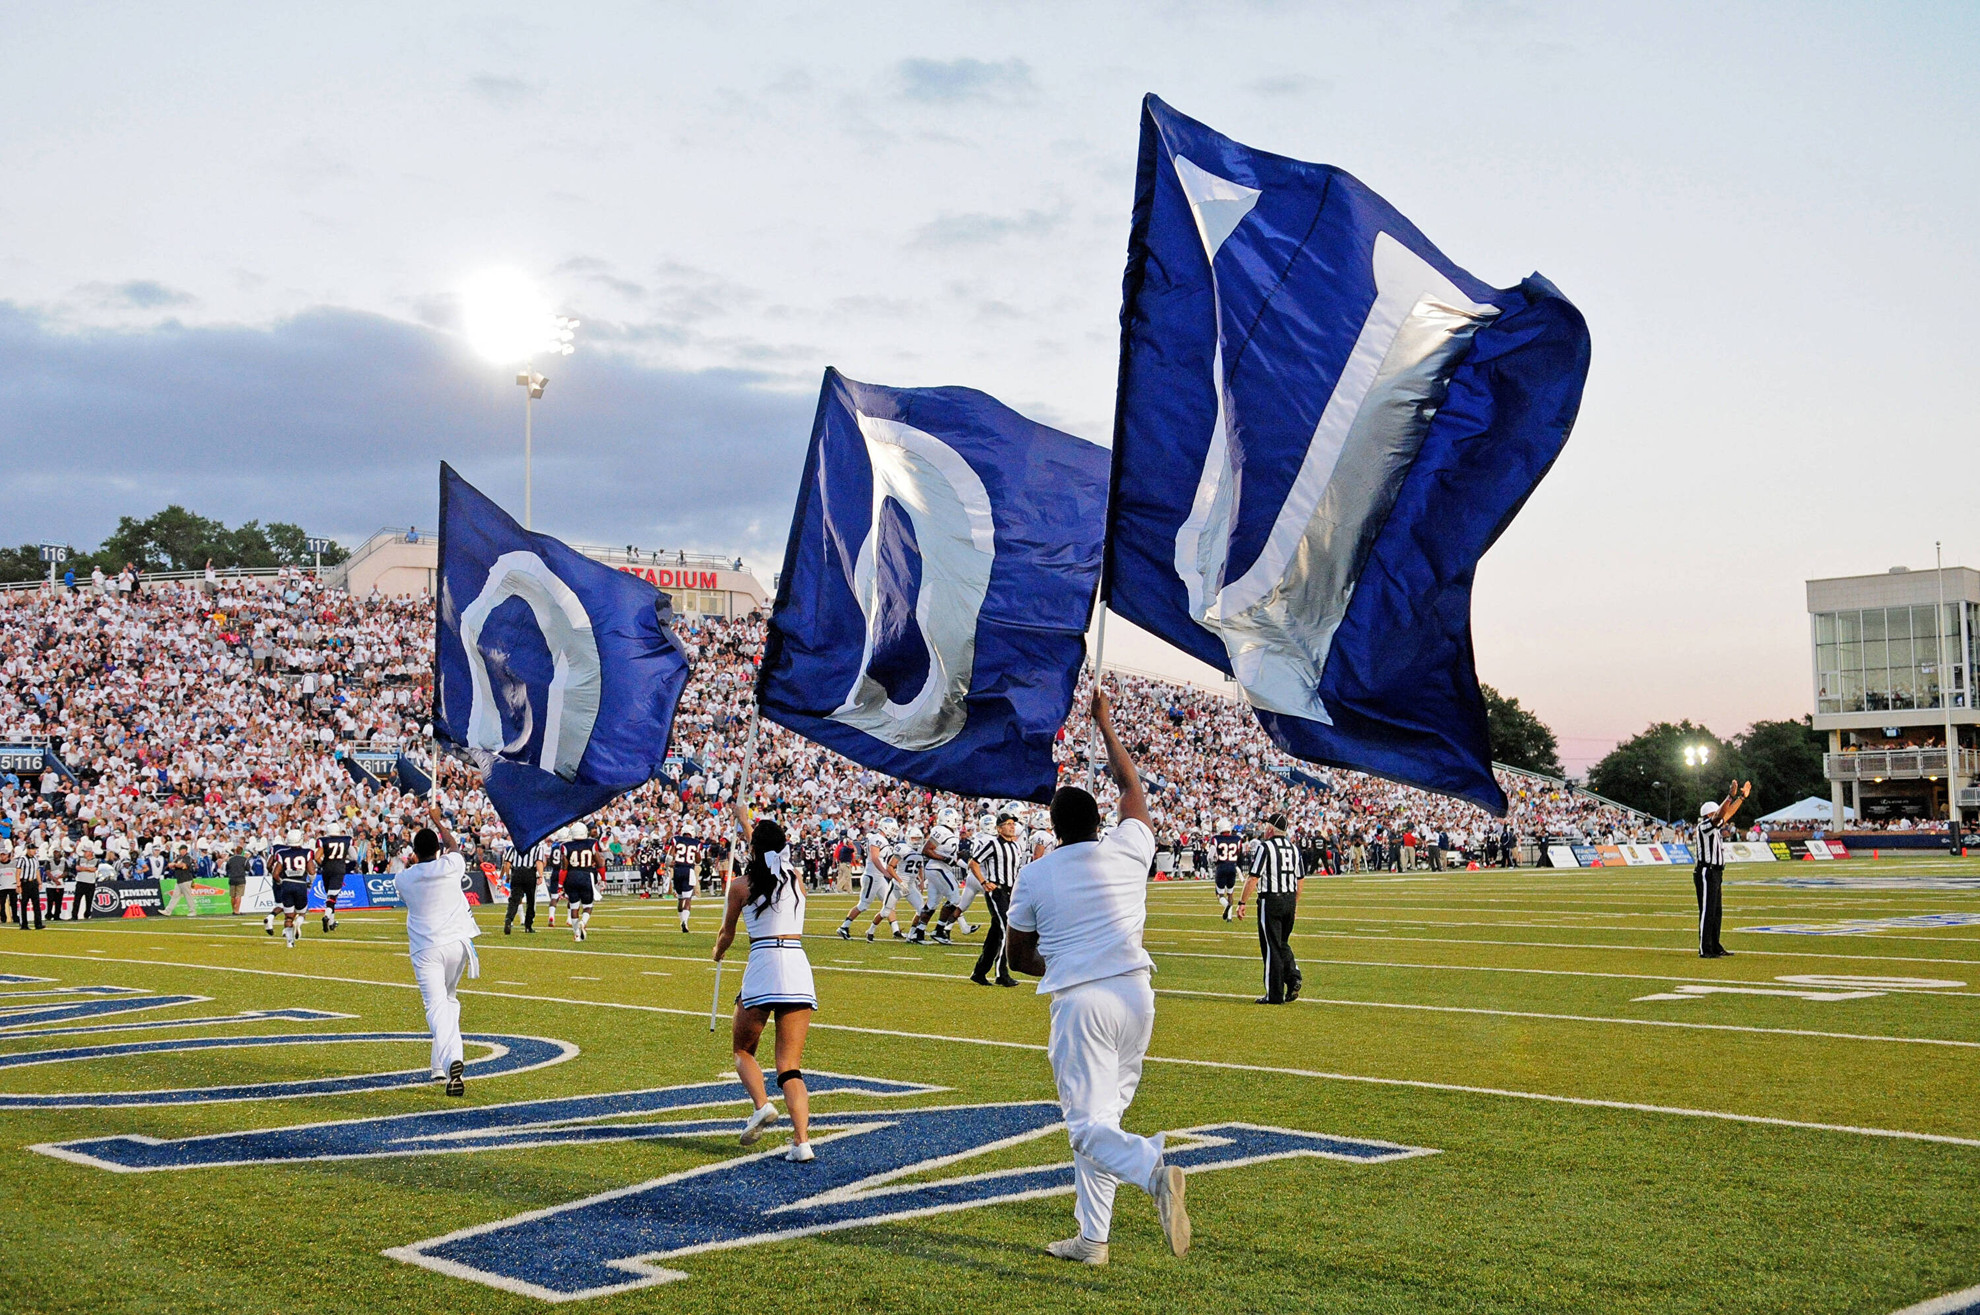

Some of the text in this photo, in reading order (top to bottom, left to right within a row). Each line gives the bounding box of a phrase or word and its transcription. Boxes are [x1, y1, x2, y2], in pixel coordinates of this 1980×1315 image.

[308, 539, 329, 552] 117
[42, 546, 66, 562] 116
[15, 756, 43, 770] 116
[374, 760, 397, 773] 117
[328, 842, 345, 859] 71
[675, 843, 695, 864] 26
[1218, 843, 1238, 862] 32
[284, 855, 306, 871] 19
[569, 850, 593, 868] 40
[1280, 848, 1295, 871] H
[904, 860, 922, 874] 29
[118, 888, 159, 898] JIMMY
[120, 898, 161, 909] JOHN'S
[130, 906, 141, 917] 10
